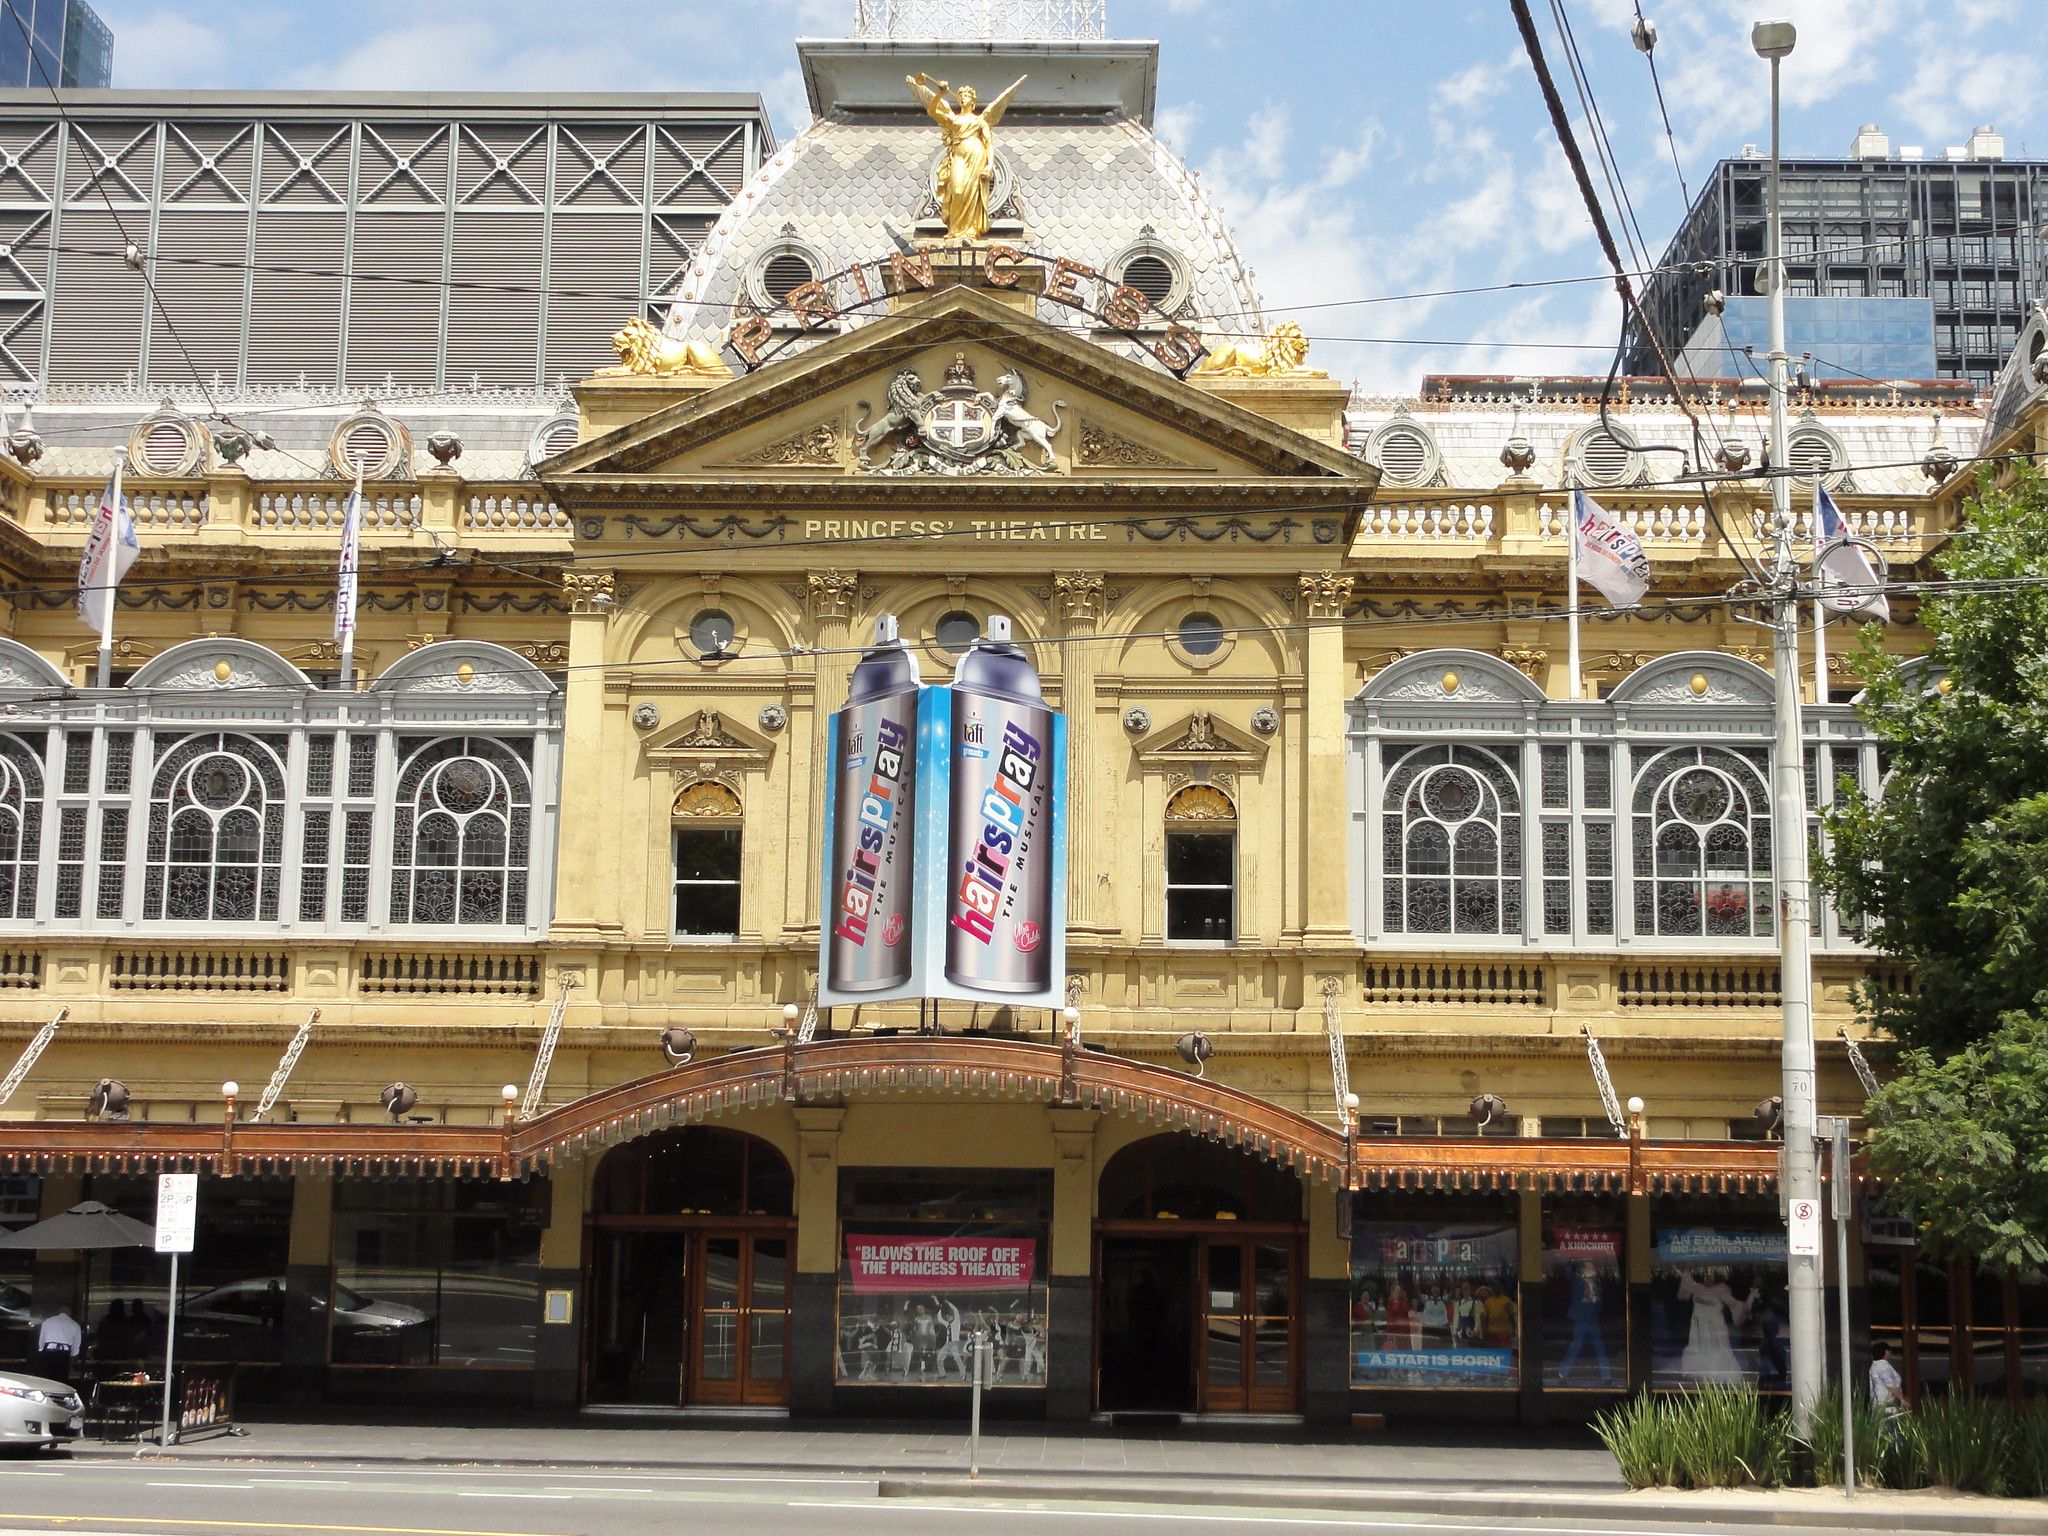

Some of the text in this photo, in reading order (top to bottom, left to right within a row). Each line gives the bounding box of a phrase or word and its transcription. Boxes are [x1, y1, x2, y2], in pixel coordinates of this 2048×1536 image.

[729, 245, 1203, 371] PRINCESS
[971, 520, 1108, 541] THEATRE
[848, 732, 864, 755] taft
[963, 722, 985, 744] taft
[834, 717, 908, 947] hairspray
[872, 769, 910, 916] THE MUSICAL
[950, 719, 1042, 946] hairspray
[1002, 782, 1045, 918] THE MUSICAL
[1792, 1081, 1808, 1093] 70
[161, 1234, 172, 1244] 1P
[915, 1246, 944, 1262] THE
[948, 1246, 987, 1262] ROOF
[992, 1247, 1020, 1263] OFF
[861, 1261, 887, 1275] THE
[891, 1262, 957, 1276] PRINCESS
[1386, 1354, 1429, 1366] STAR
[1432, 1355, 1448, 1366] IS
